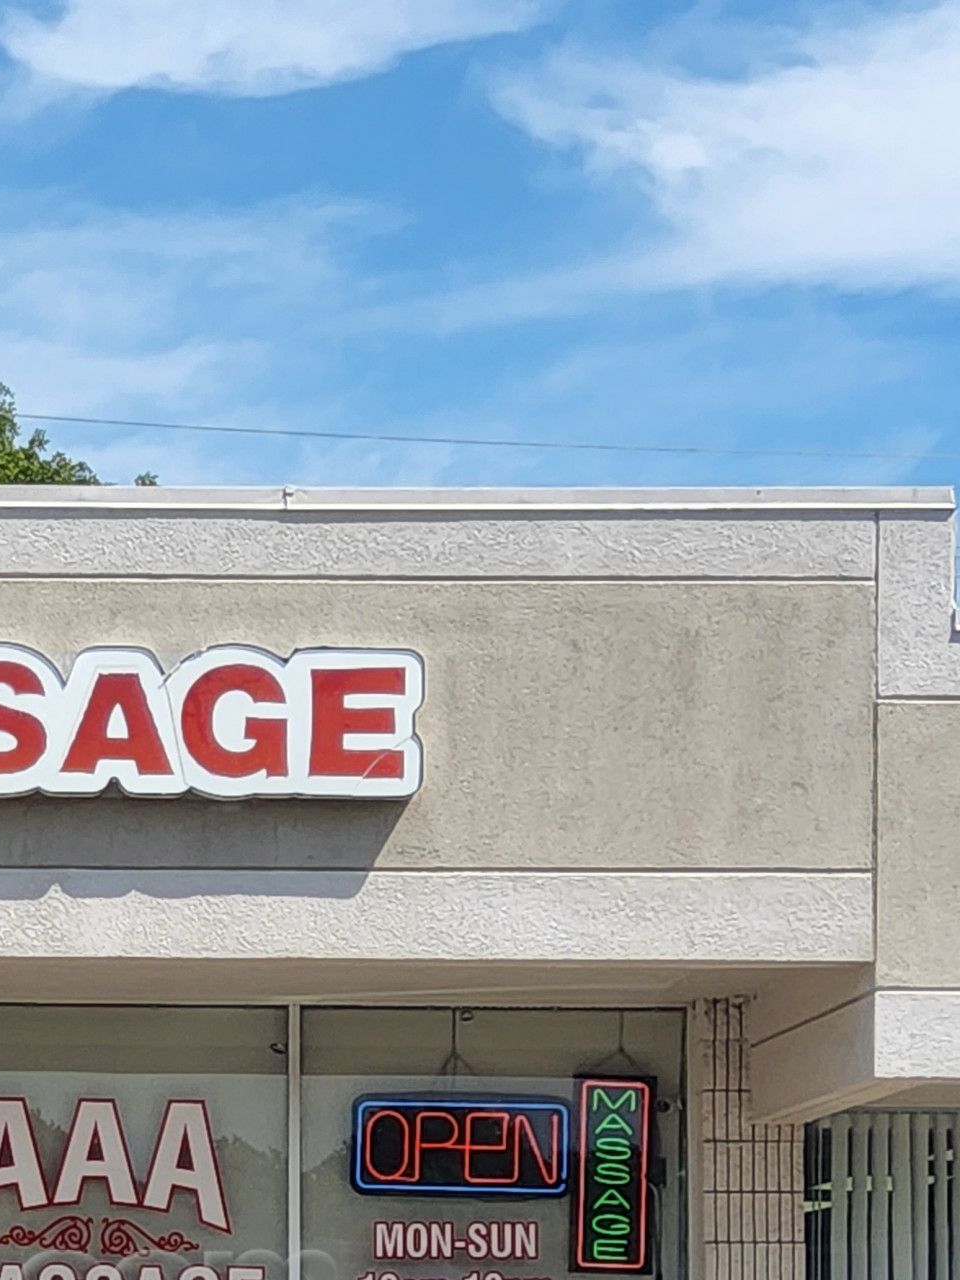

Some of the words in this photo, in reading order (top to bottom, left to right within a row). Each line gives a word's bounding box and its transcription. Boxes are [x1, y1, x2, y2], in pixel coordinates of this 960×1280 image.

[365, 1109, 559, 1185] OPEN
[591, 1087, 637, 1262] MASSAGE
[374, 1221, 539, 1260] MON-SUN
